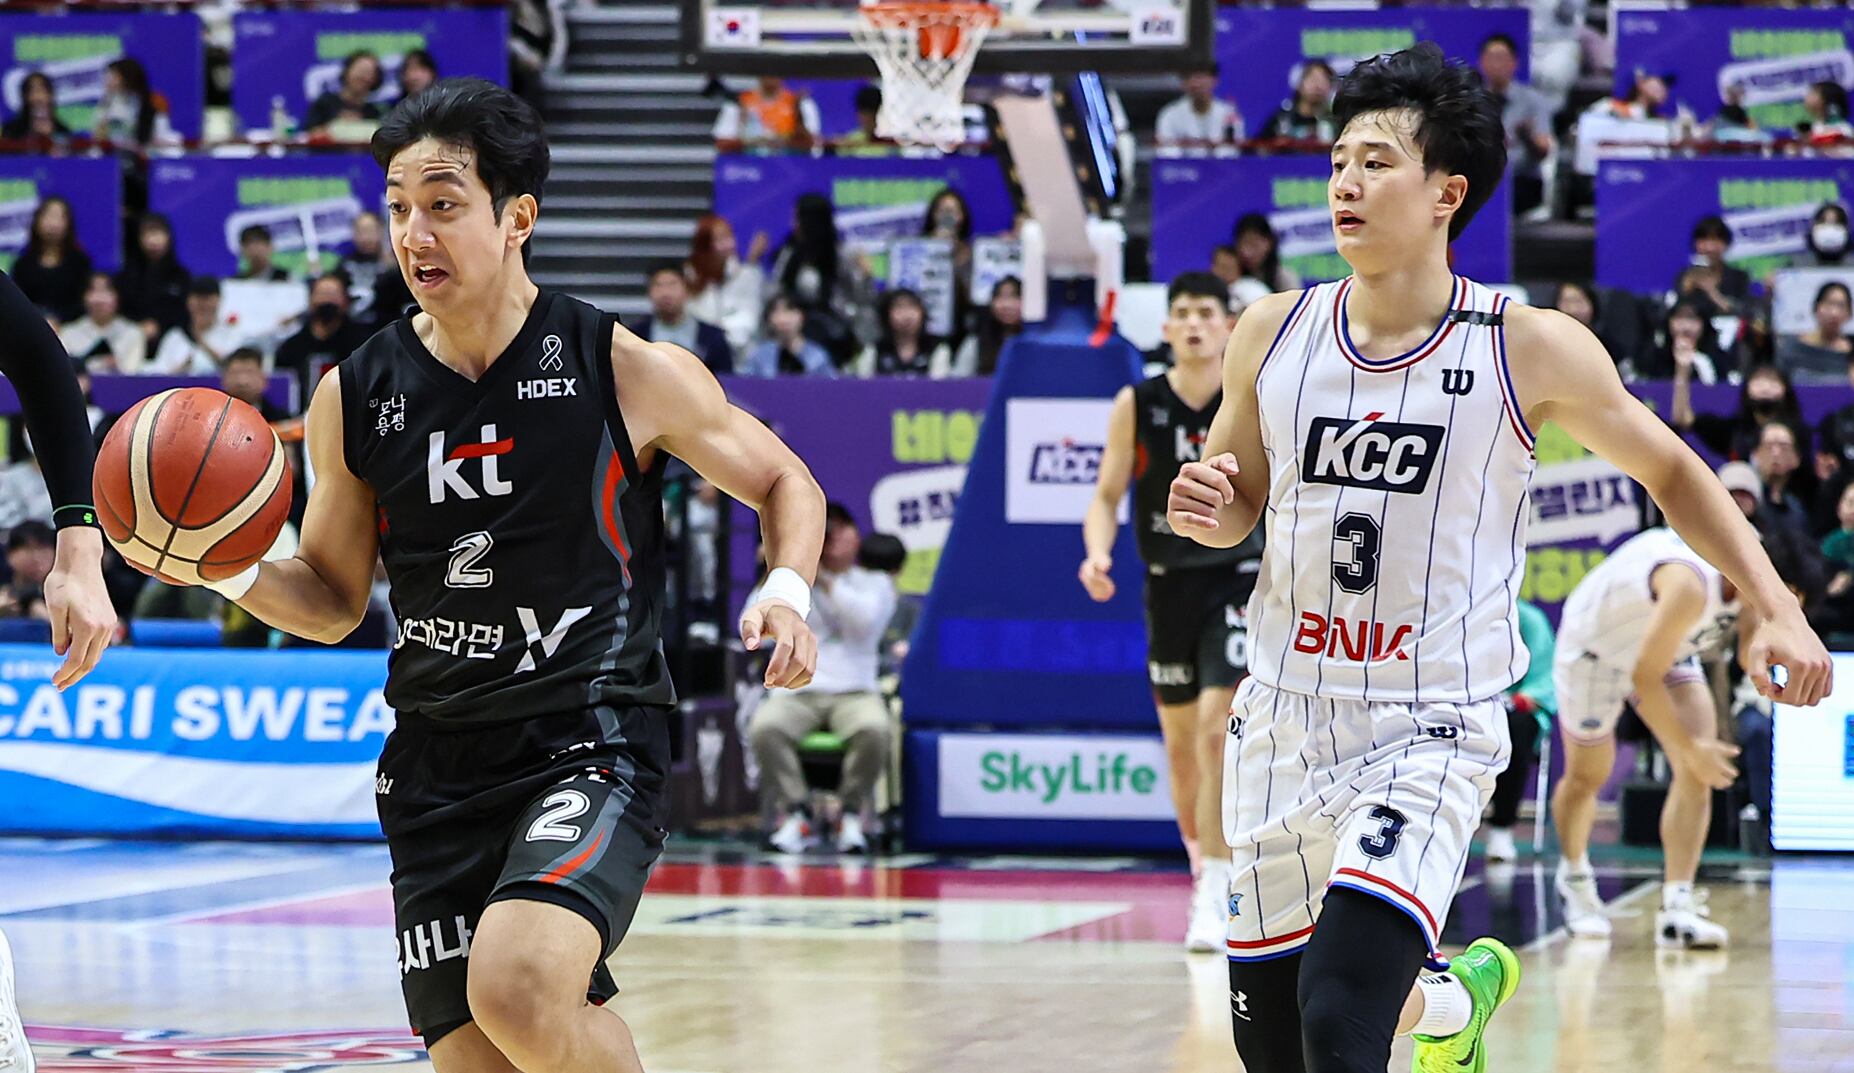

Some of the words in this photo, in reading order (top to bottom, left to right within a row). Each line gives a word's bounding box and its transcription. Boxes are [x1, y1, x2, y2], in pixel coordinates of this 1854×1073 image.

[517, 378, 577, 400] HDEX
[427, 423, 514, 504] kt
[1313, 412, 1428, 486] KCC
[444, 530, 494, 588] 2
[1332, 511, 1381, 595] 3
[1294, 611, 1412, 663] BNK
[980, 751, 1157, 803] SkyLife
[525, 789, 591, 842] 2
[1357, 805, 1409, 861] 3
[395, 914, 473, 981] 사나
